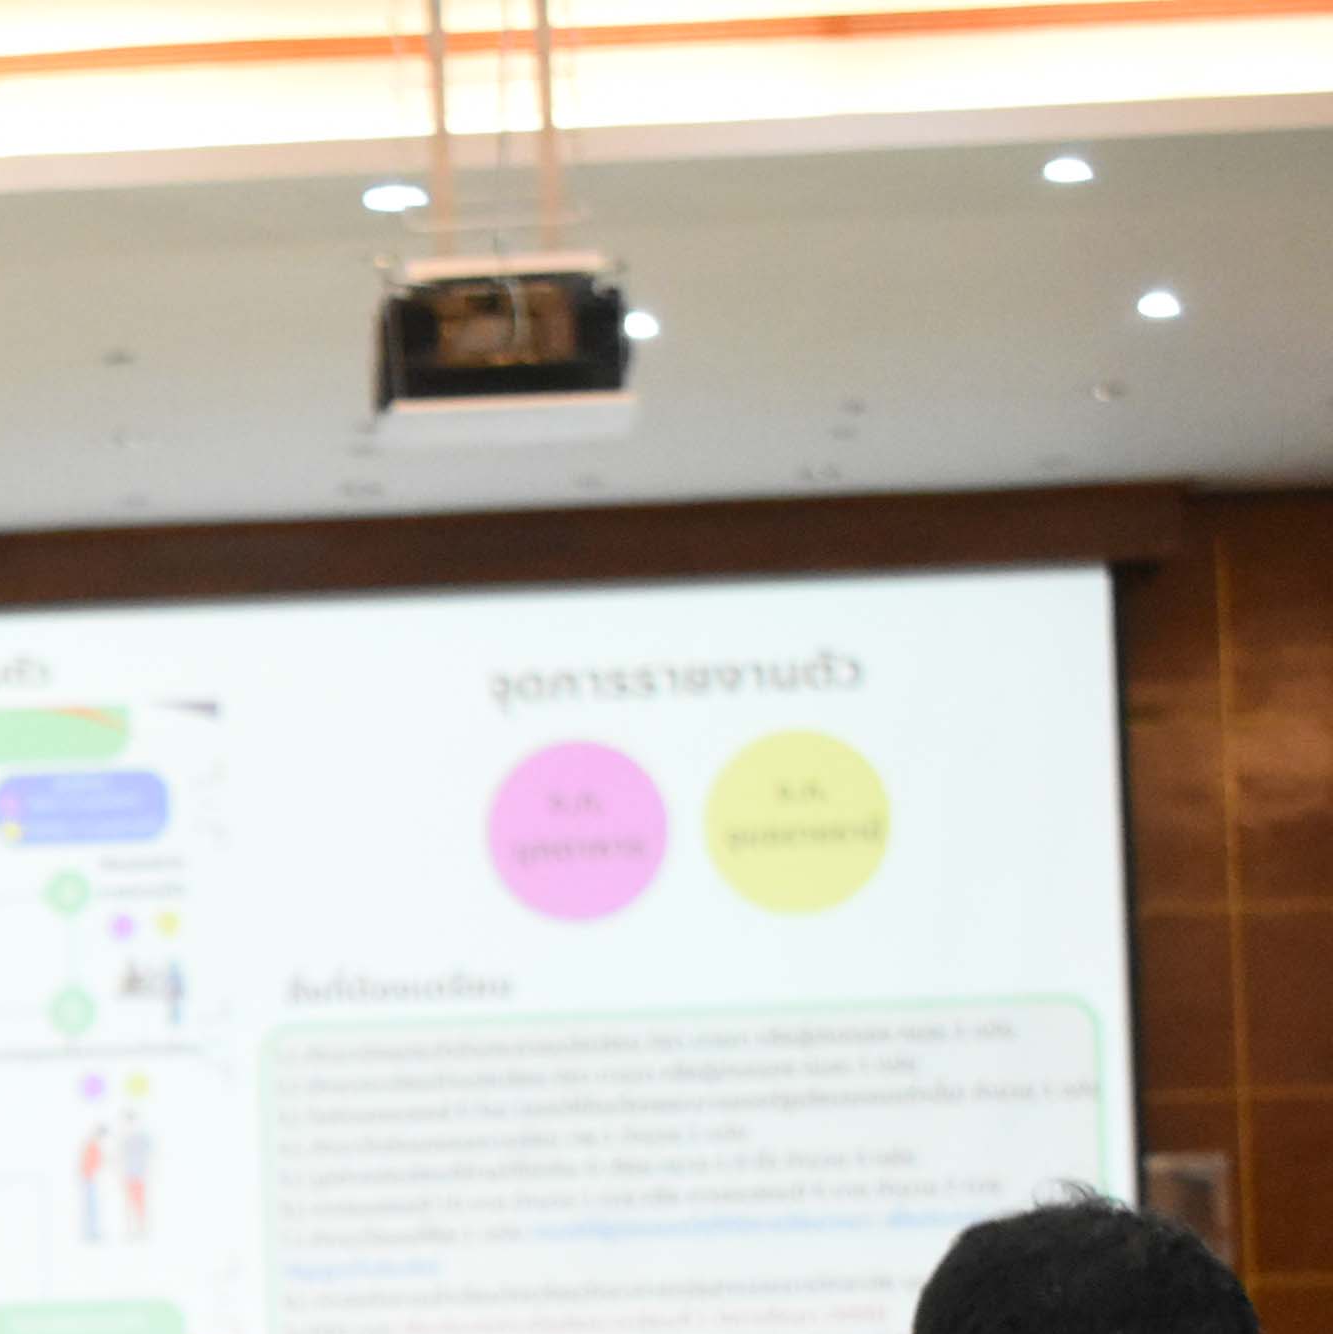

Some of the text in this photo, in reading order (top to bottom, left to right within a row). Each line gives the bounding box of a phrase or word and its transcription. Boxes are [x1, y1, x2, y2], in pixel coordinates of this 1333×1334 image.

[489, 645, 864, 716] จุดการรายงานตัว
